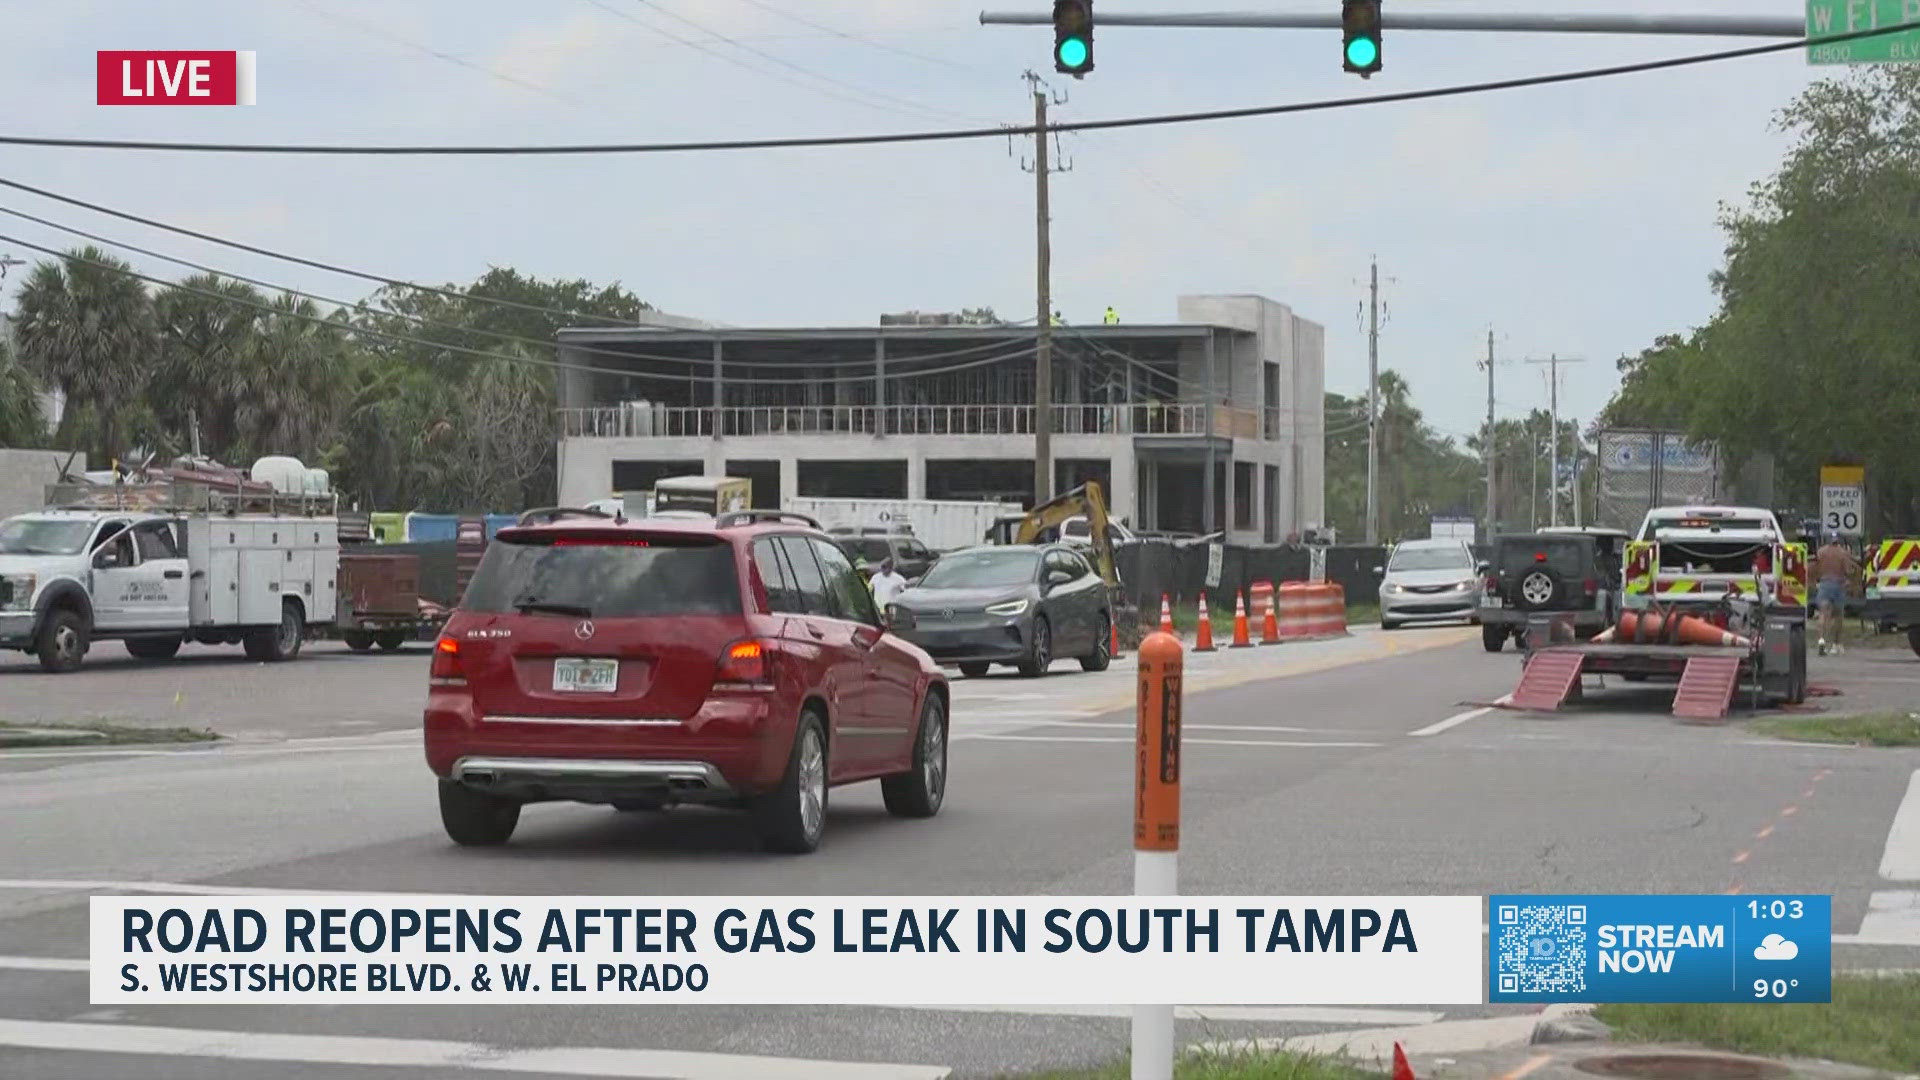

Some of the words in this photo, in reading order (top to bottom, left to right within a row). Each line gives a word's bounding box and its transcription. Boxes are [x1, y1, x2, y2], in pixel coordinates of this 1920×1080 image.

[1813, 6, 1832, 32] W
[1813, 46, 1851, 62] 4800
[1827, 489, 1859, 498] SPEED
[1829, 499, 1855, 508] LIMIT
[1827, 512, 1858, 530] 30
[1166, 677, 1179, 782] WARNING
